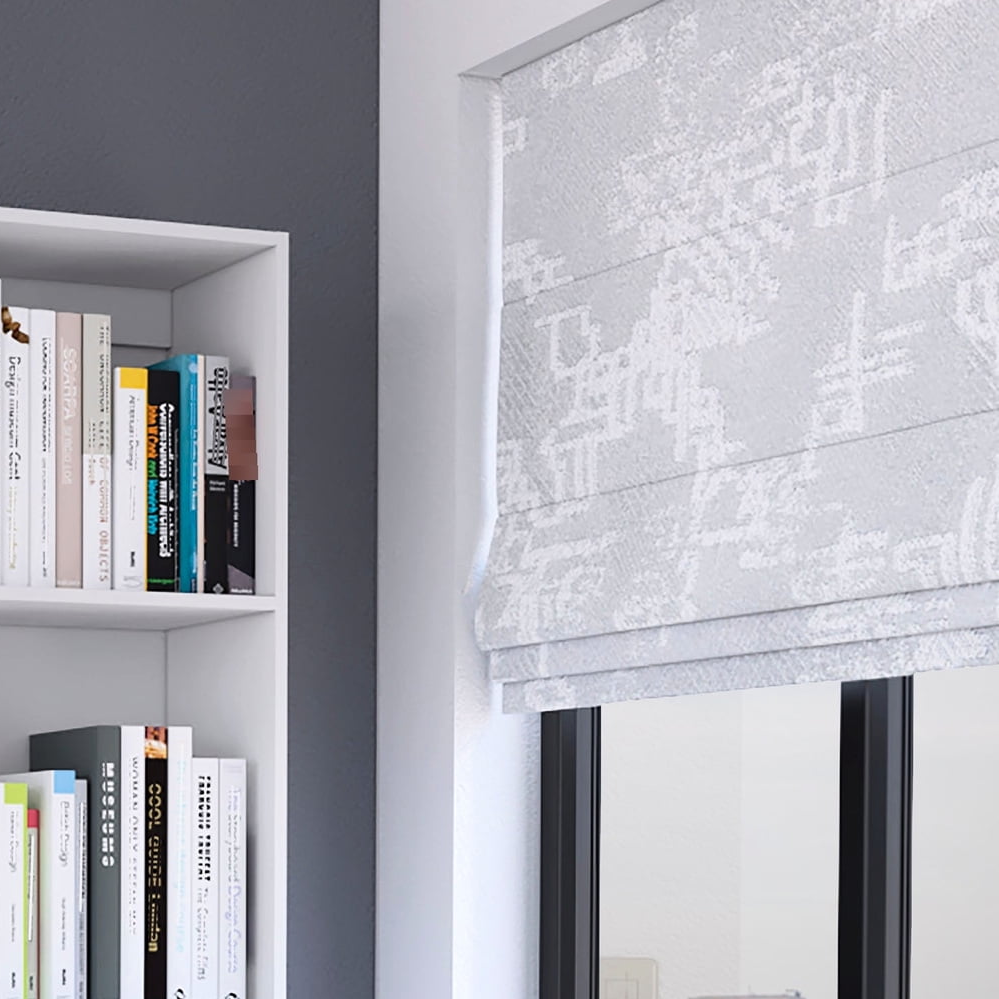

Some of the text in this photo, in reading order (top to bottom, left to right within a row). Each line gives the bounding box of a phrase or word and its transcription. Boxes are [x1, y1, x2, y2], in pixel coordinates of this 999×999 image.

[62, 347, 78, 421] SCARPA
[98, 353, 109, 414] UNCOMMON
[99, 479, 109, 523] COMMON
[159, 403, 175, 558] Conversations with Architects
[99, 530, 109, 582] OBJECTS
[129, 757, 139, 811] WOMAN
[102, 762, 114, 868] MUSEUMS
[129, 816, 139, 853] ONLY
[148, 783, 161, 953] COOL GUIDE London
